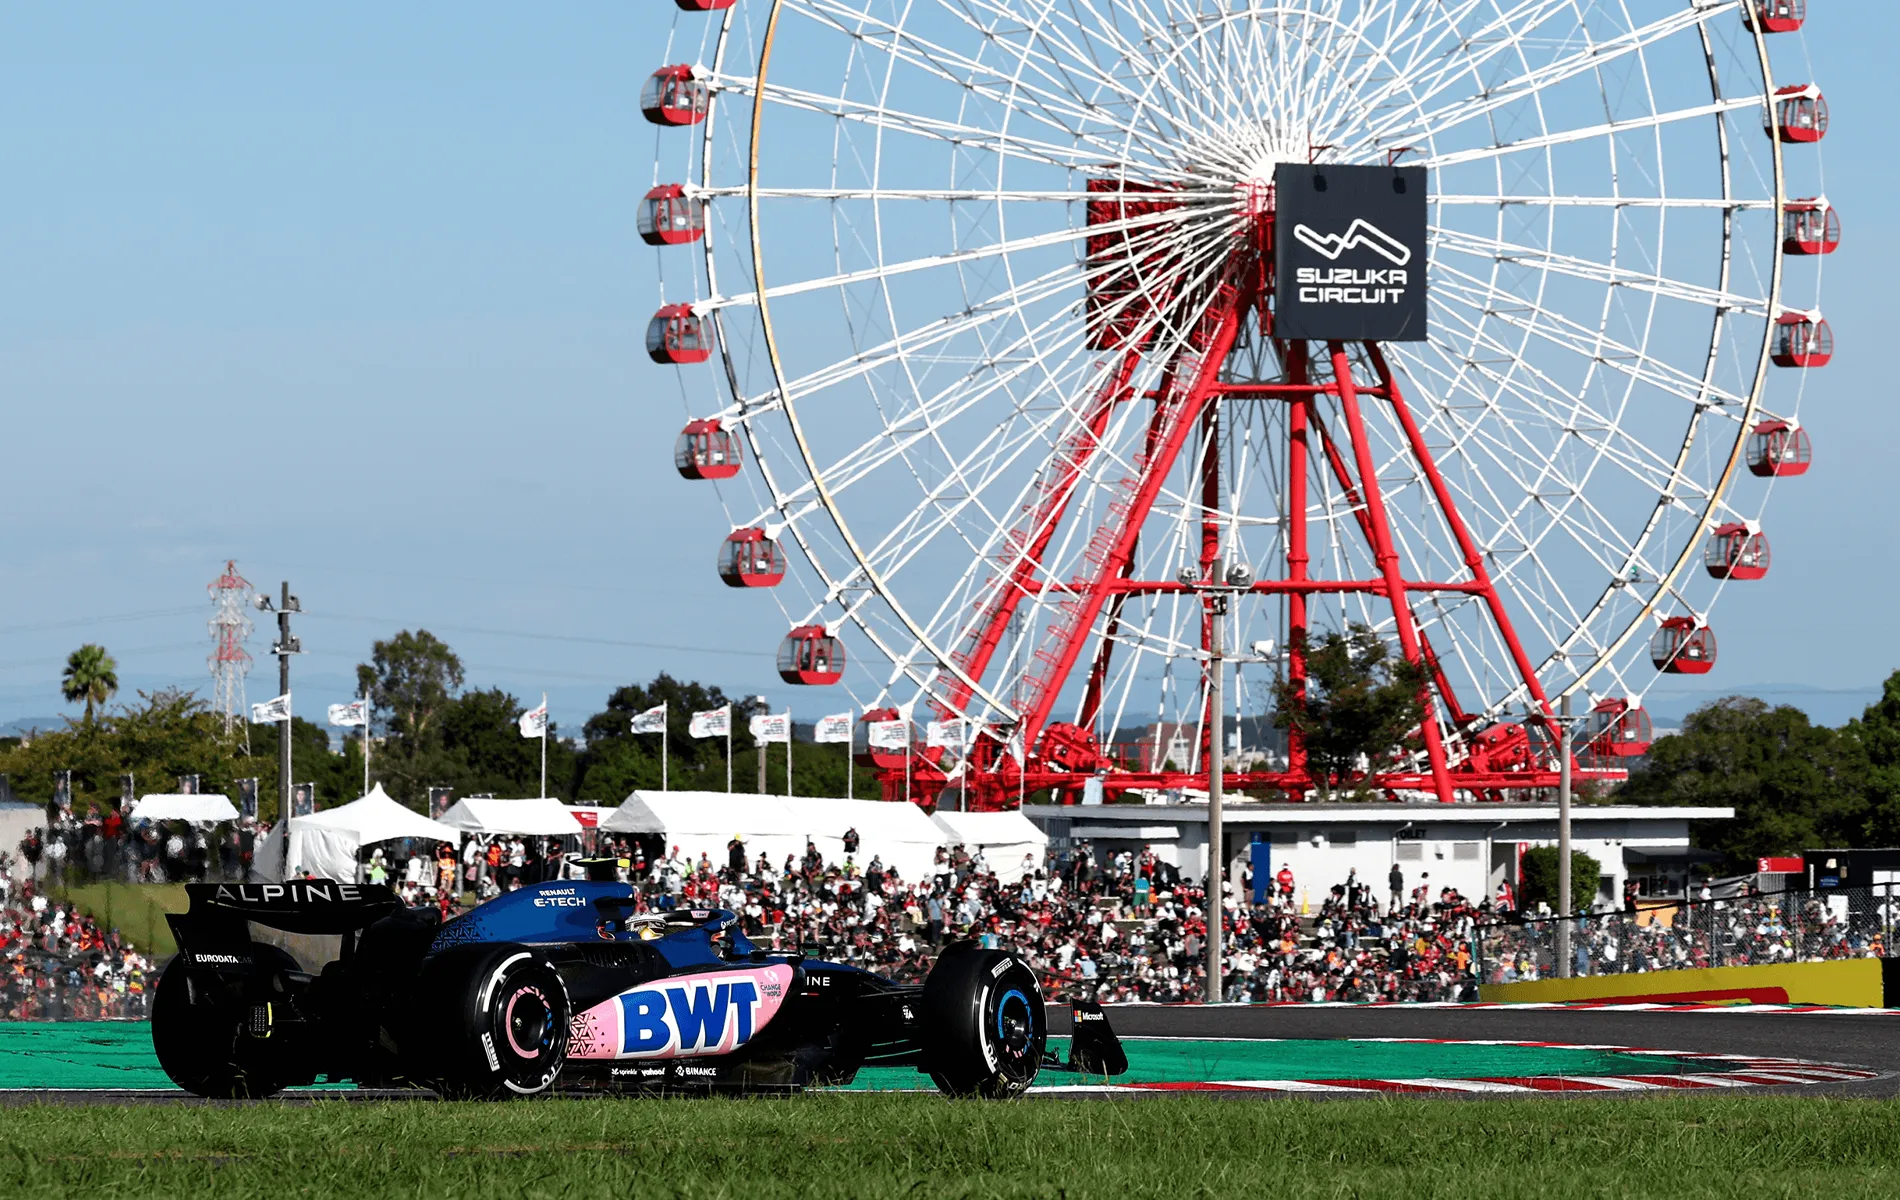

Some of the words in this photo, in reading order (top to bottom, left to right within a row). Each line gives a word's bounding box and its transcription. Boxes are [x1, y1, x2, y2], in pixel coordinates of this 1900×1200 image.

[1296, 268, 1407, 285] SUZUKA
[1299, 287, 1404, 304] CIRCUIT
[215, 884, 363, 903] ALPINE
[538, 888, 576, 897] RENAULT
[533, 897, 587, 908] E-TECH
[618, 980, 759, 1055] BWT
[1082, 1011, 1104, 1021] Microsoft
[685, 1067, 717, 1077] BINANCE
